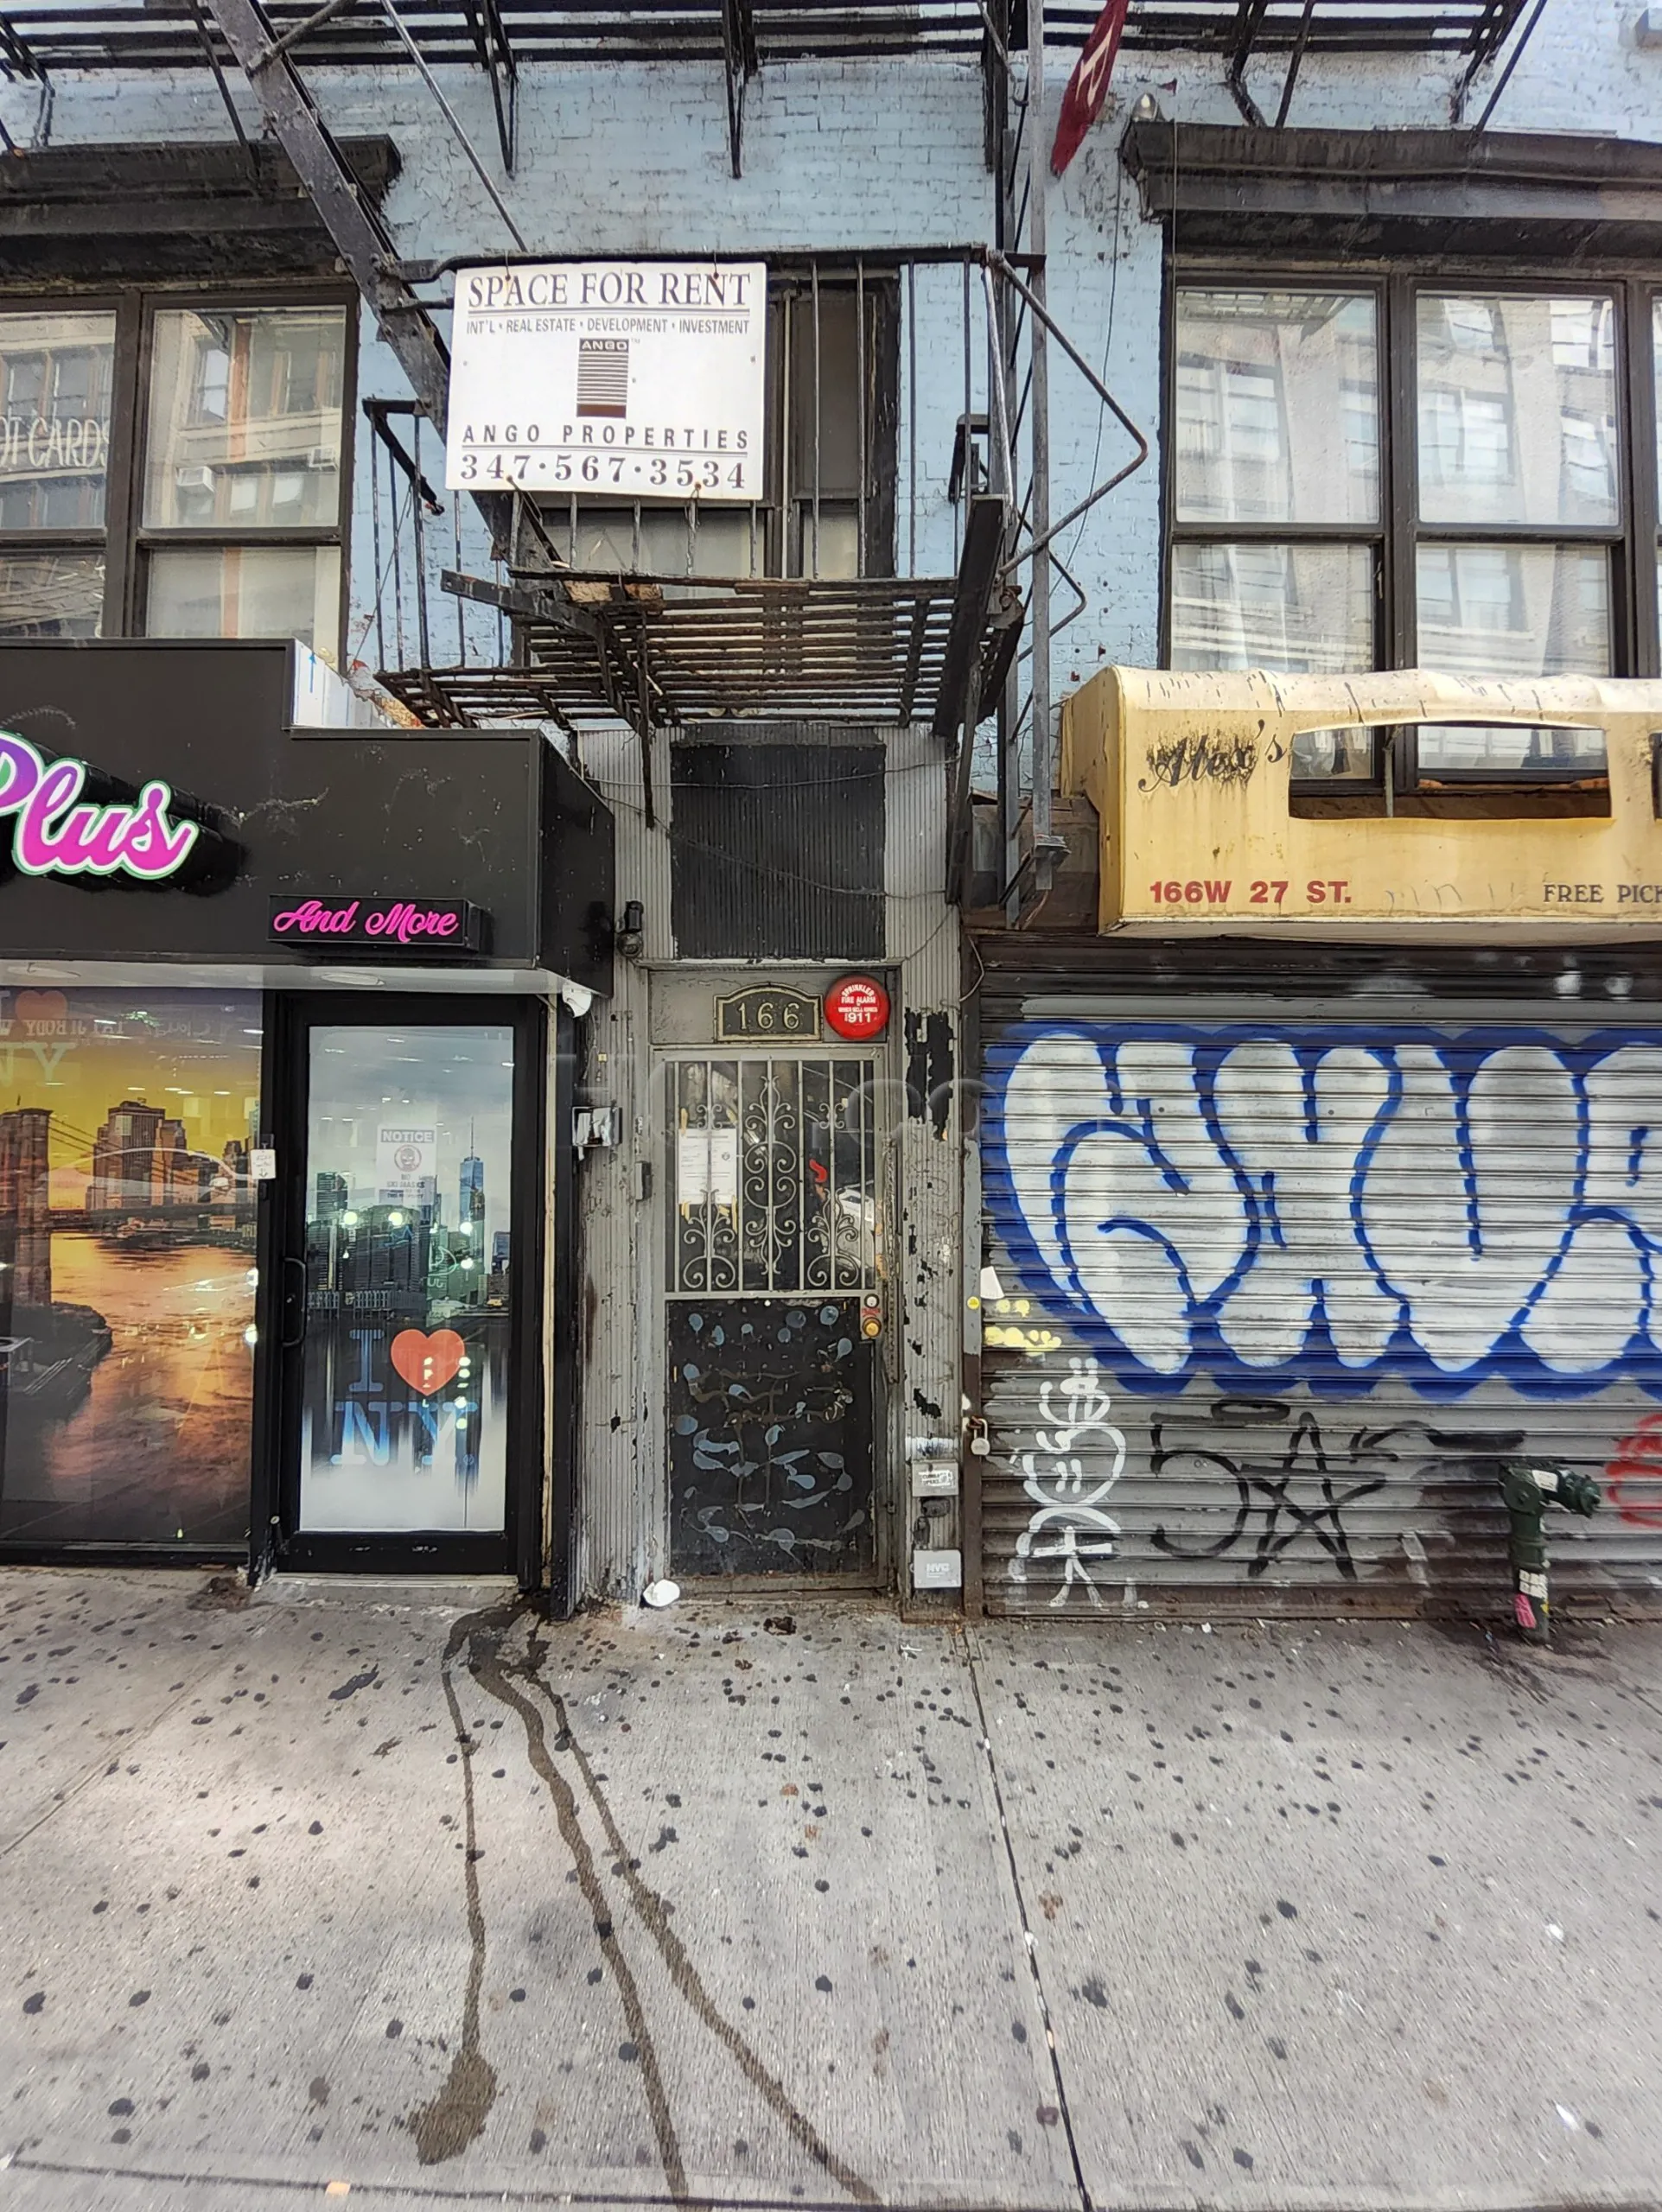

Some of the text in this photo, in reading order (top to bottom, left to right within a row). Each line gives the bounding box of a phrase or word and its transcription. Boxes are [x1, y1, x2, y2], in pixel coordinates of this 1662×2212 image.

[468, 271, 751, 308] SPACE FOR RENT
[467, 317, 750, 335] INT'L REAL ESTATE DEVELOPMENT INVESTMENT
[581, 340, 628, 351] ANGO
[462, 424, 748, 449] ANGO PROPERTIES
[1149, 880, 1232, 904] 166W
[1249, 880, 1289, 904] 27
[1306, 880, 1353, 904] ST.
[1543, 884, 1605, 904] FREE
[273, 899, 460, 944] And More
[735, 1001, 800, 1031] 166
[848, 1012, 871, 1024] 911
[382, 1130, 433, 1142] NOTICE
